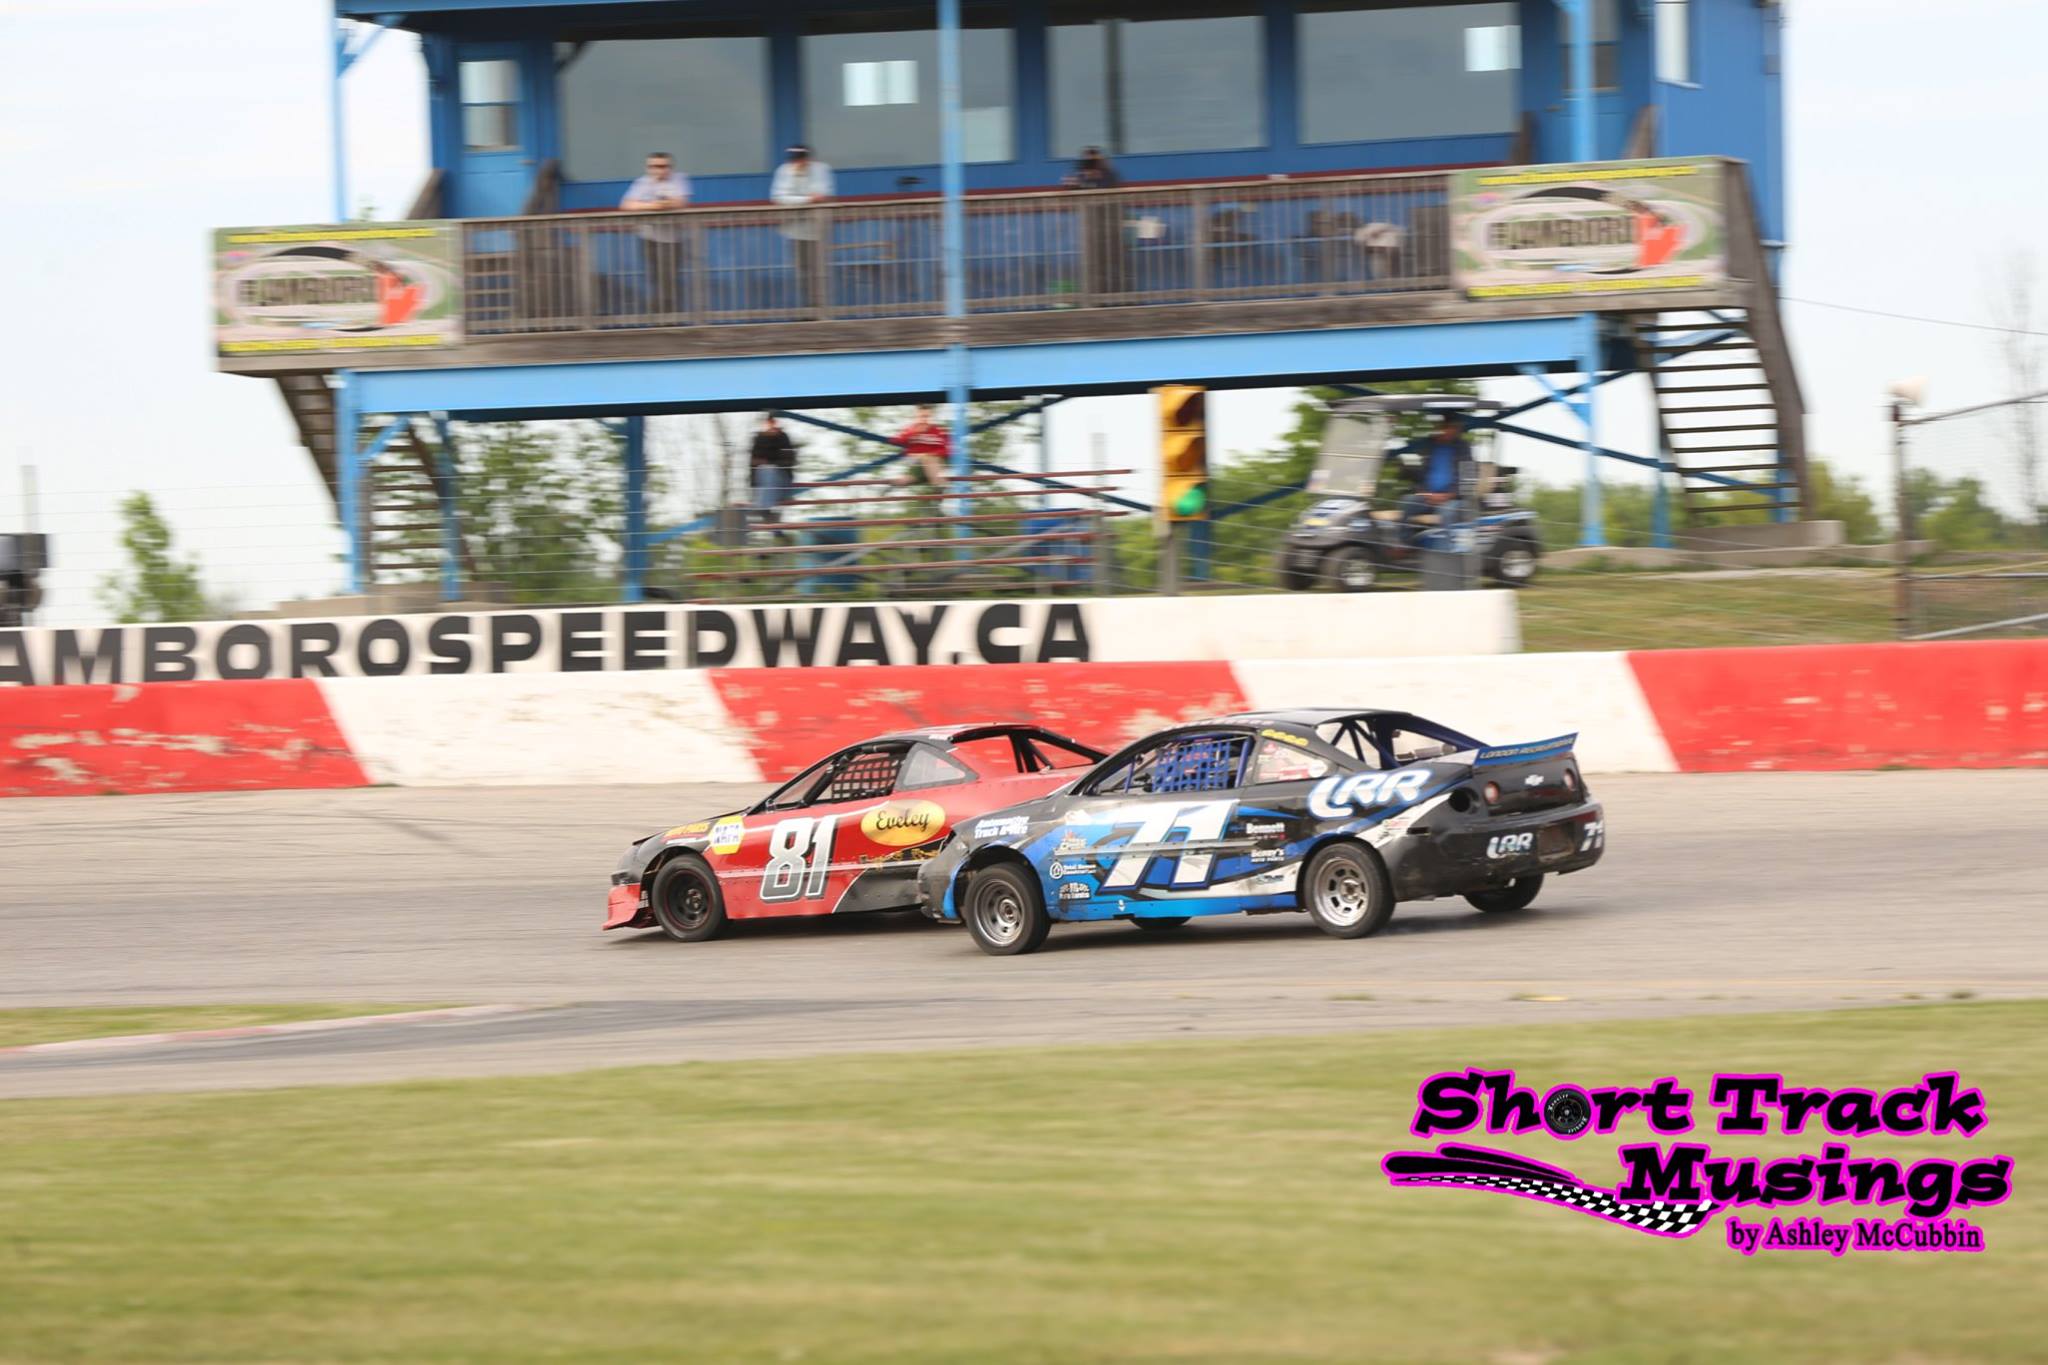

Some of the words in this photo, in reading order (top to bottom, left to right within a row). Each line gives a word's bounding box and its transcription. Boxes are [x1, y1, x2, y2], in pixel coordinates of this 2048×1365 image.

[1310, 769, 1431, 819] LRR
[875, 808, 930, 832] Eveley
[760, 815, 840, 902] 81
[1486, 832, 1533, 859] LRR
